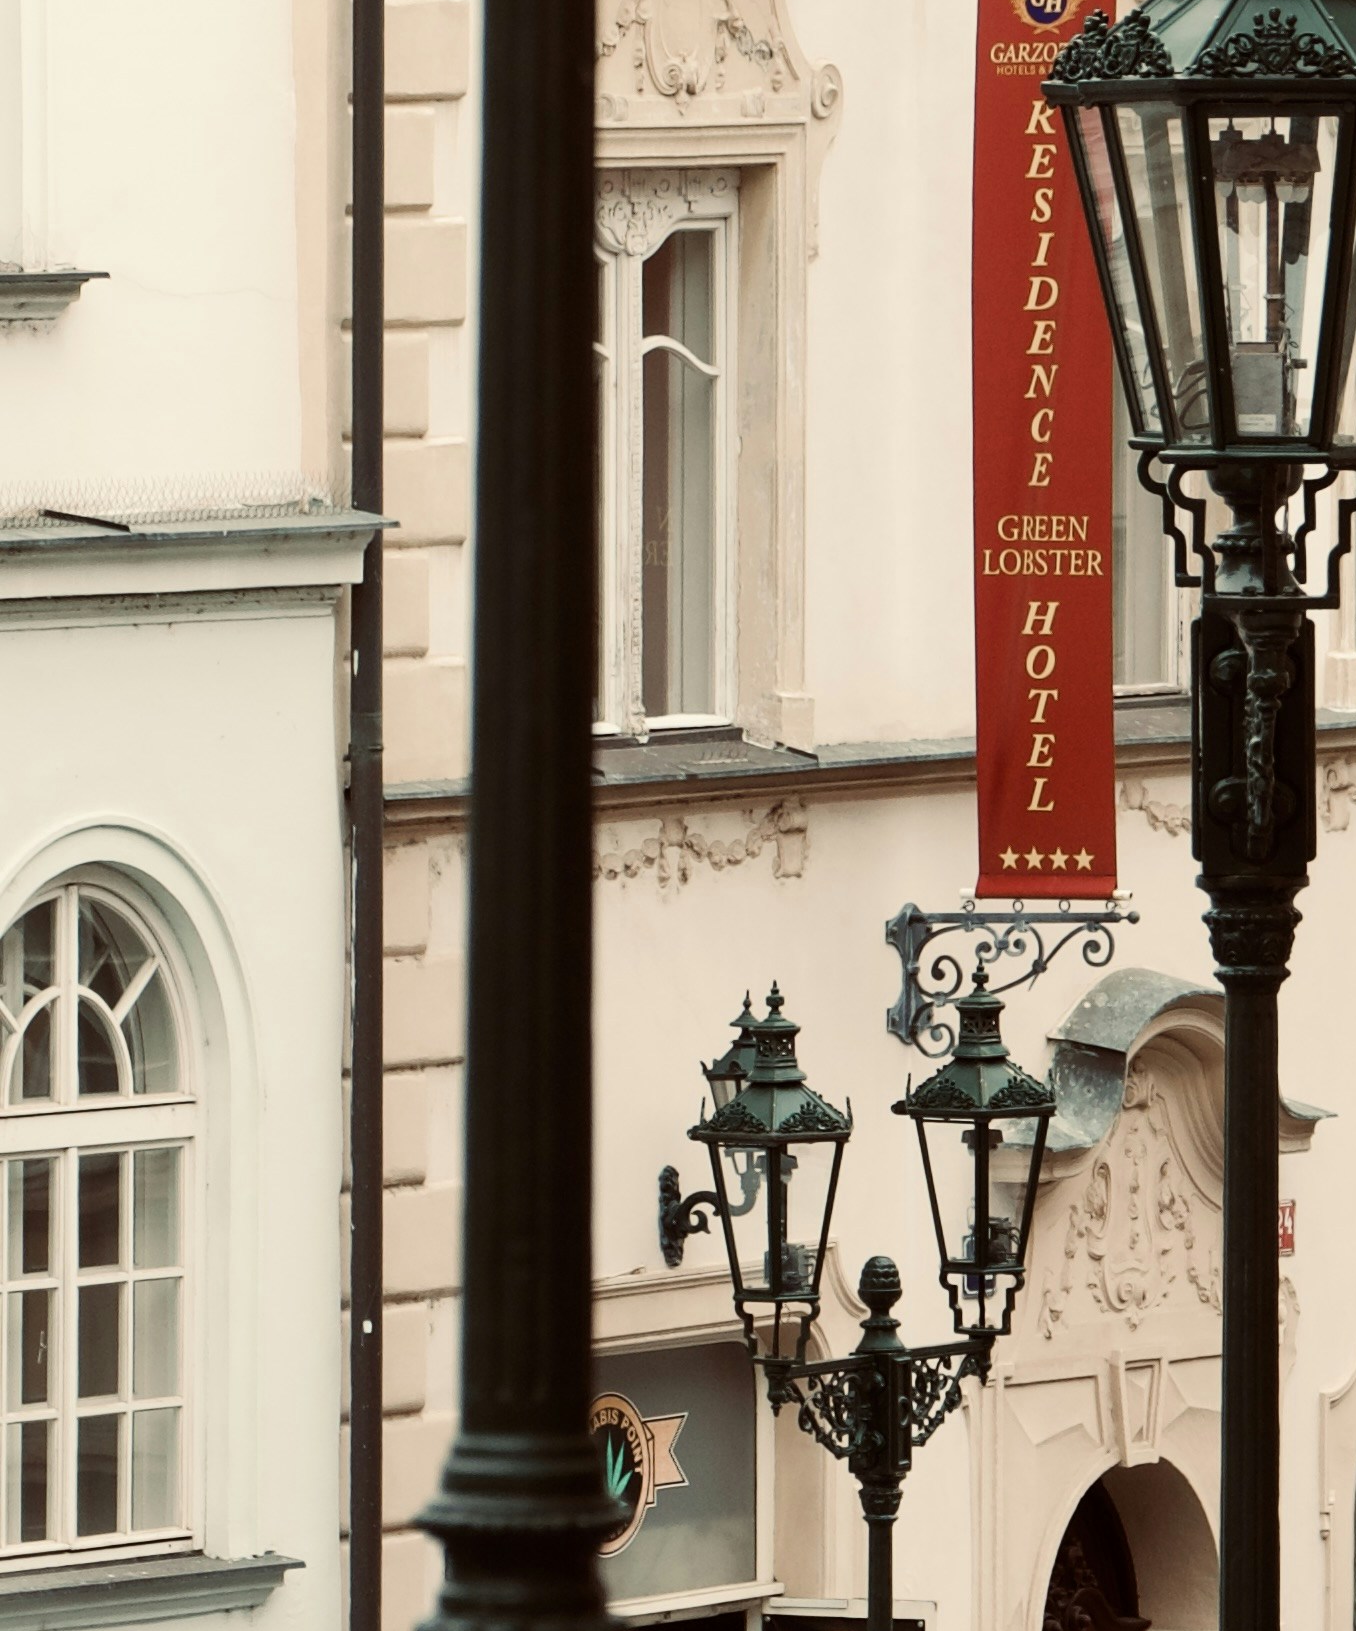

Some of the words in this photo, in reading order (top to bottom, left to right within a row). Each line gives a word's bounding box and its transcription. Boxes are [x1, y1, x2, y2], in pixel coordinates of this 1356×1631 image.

[997, 64, 1036, 76] HOTELS
[1024, 99, 1060, 488] RESIDENCE
[997, 515, 1090, 542] GREEN
[982, 549, 1104, 576] LOBSTER
[1021, 601, 1060, 813] HOTEL
